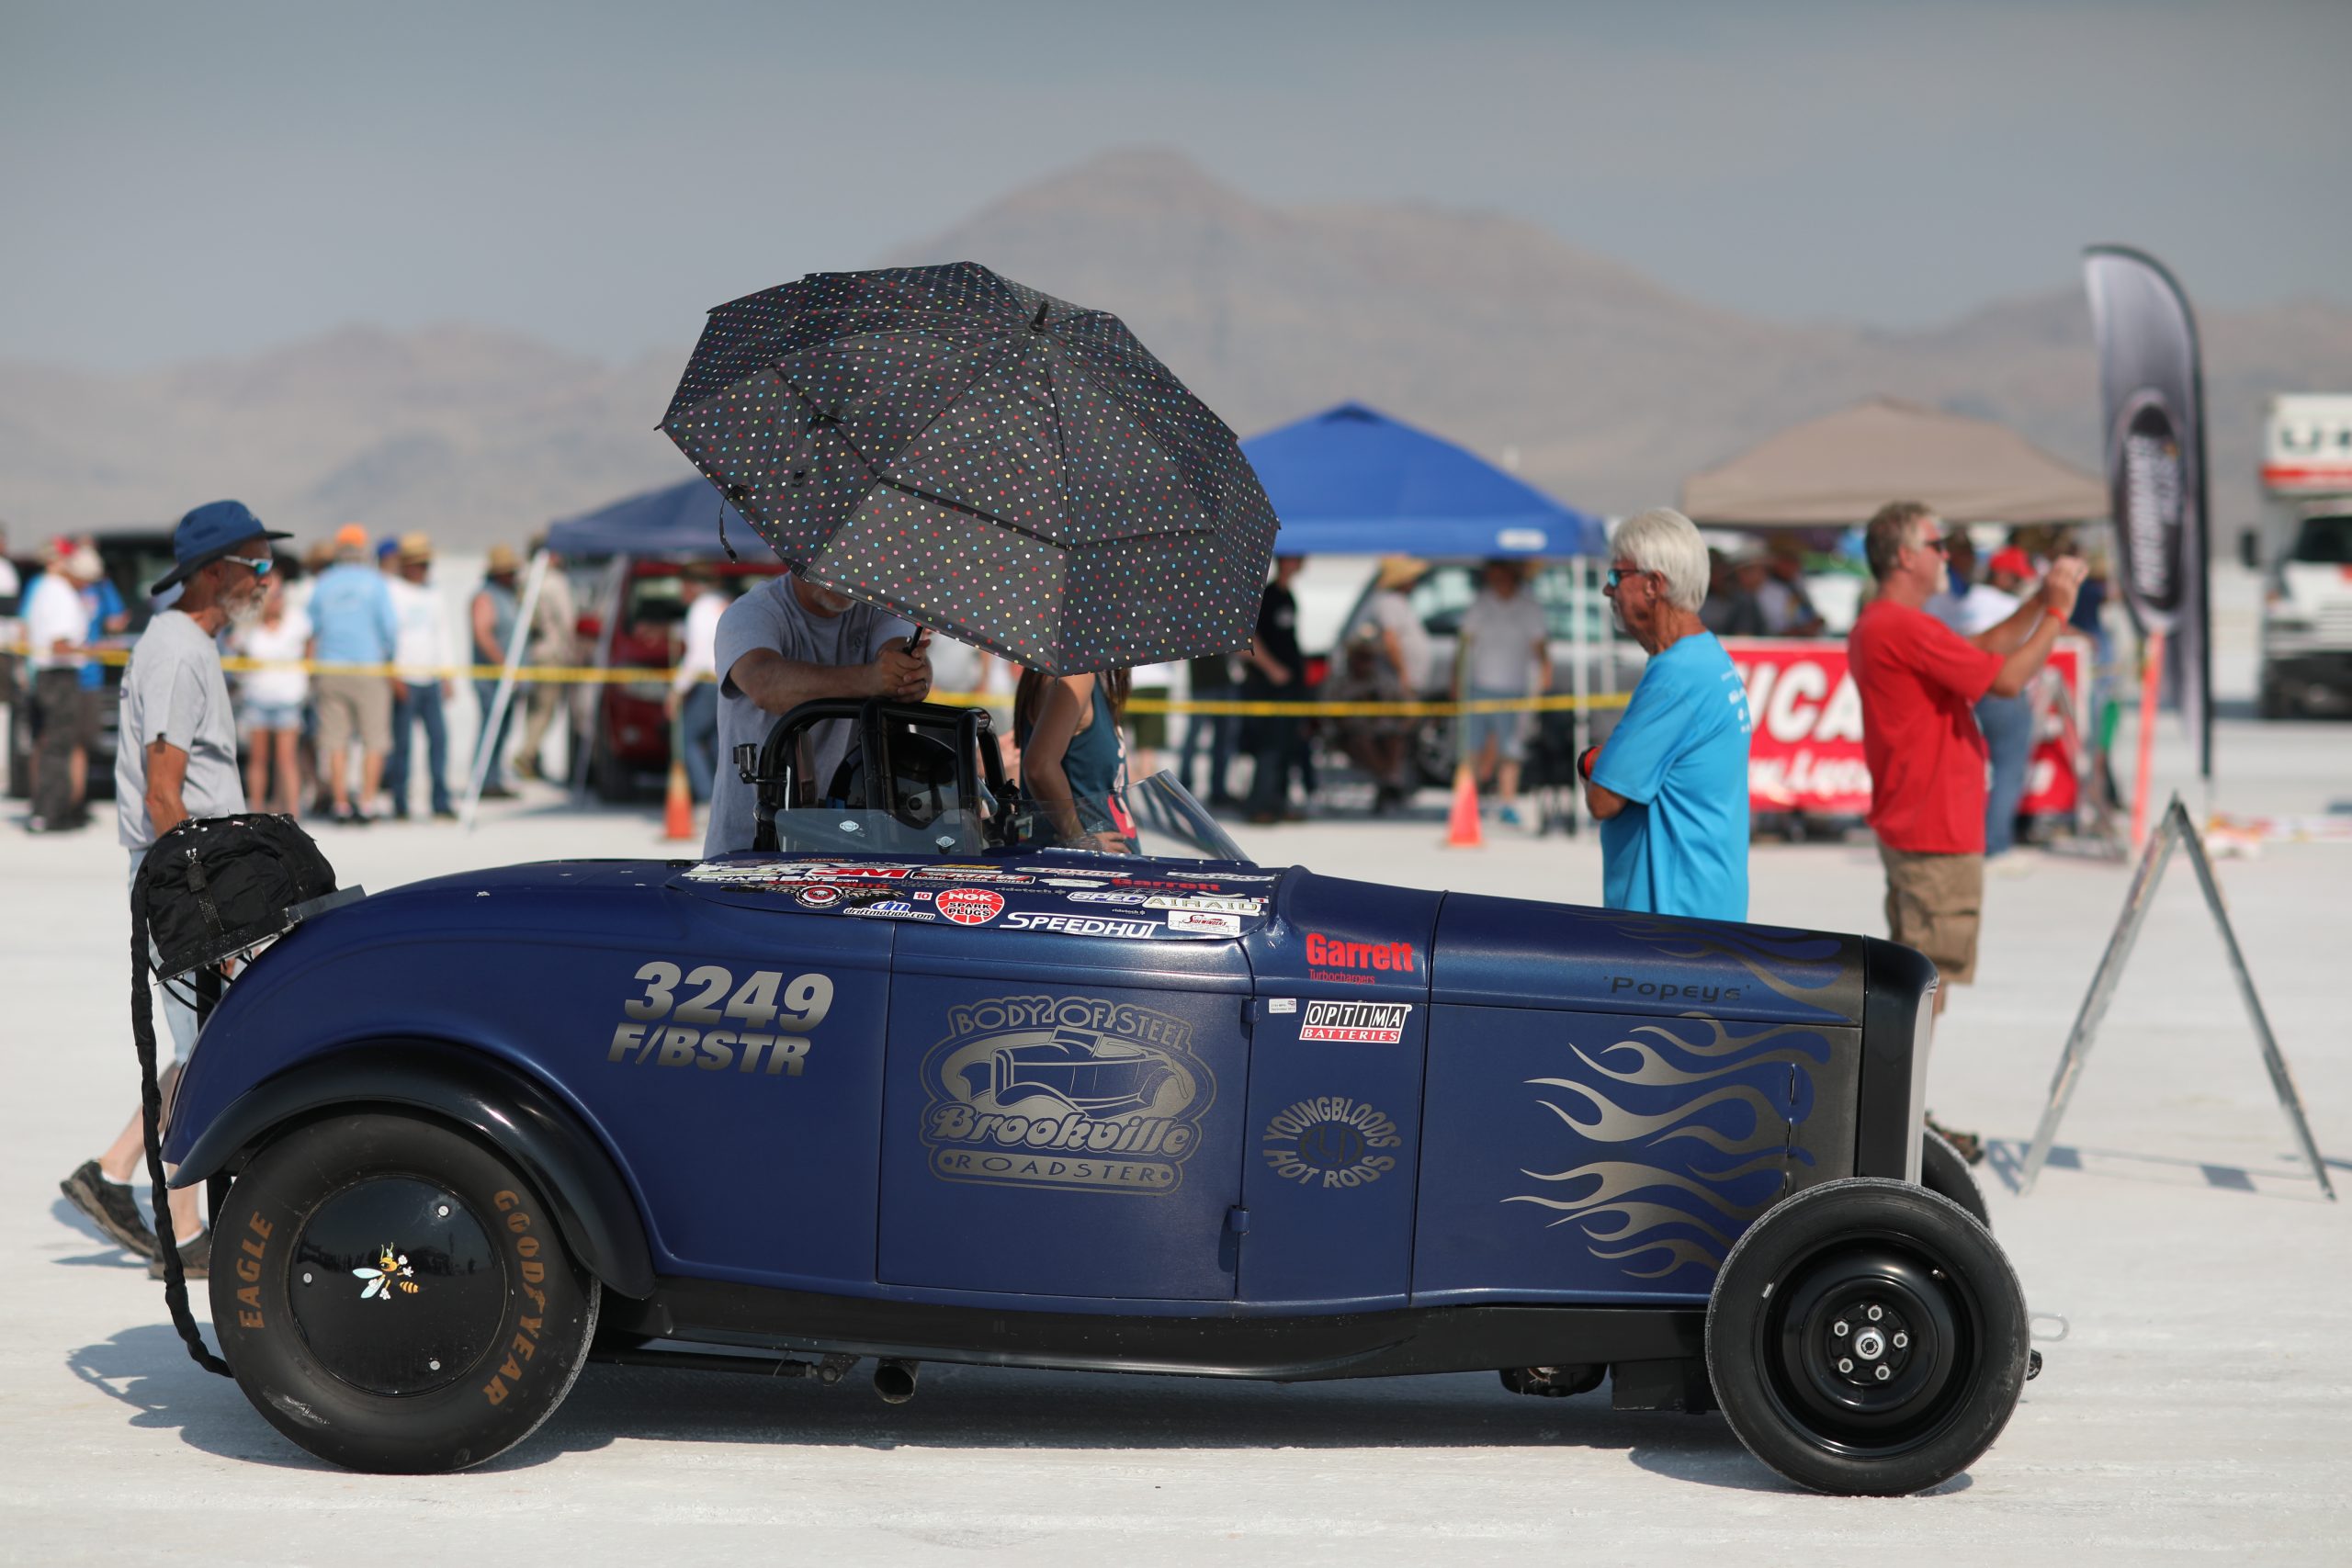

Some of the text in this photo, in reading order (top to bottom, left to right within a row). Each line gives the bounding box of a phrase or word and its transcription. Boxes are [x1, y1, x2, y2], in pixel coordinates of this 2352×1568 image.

[808, 868, 908, 879] 3M
[948, 893, 993, 902] NGK
[1071, 892, 1144, 903] SPEC
[1148, 897, 1258, 911] AIRAID
[844, 907, 935, 919] driftmotion.com
[948, 908, 990, 917] PLUGS
[1000, 912, 1166, 940] SPEEDHUT
[1306, 933, 1415, 972] Garrett
[1308, 968, 1375, 985] Turbochargers
[625, 961, 834, 1032] 3249
[956, 1003, 1187, 1052] BODY OF STEEL
[1306, 1002, 1407, 1029] OPTIMA
[606, 1022, 811, 1077] F/BSTR
[1303, 1029, 1398, 1042] BATTERIES
[931, 1105, 1193, 1155] Brookville
[1263, 1096, 1402, 1147] YOUNGBLOODS
[956, 1154, 1155, 1182] ROADSTER
[1263, 1149, 1396, 1188] HOT RODS
[237, 1211, 275, 1329] EAGLE
[482, 1190, 547, 1406] GOODYEAR
